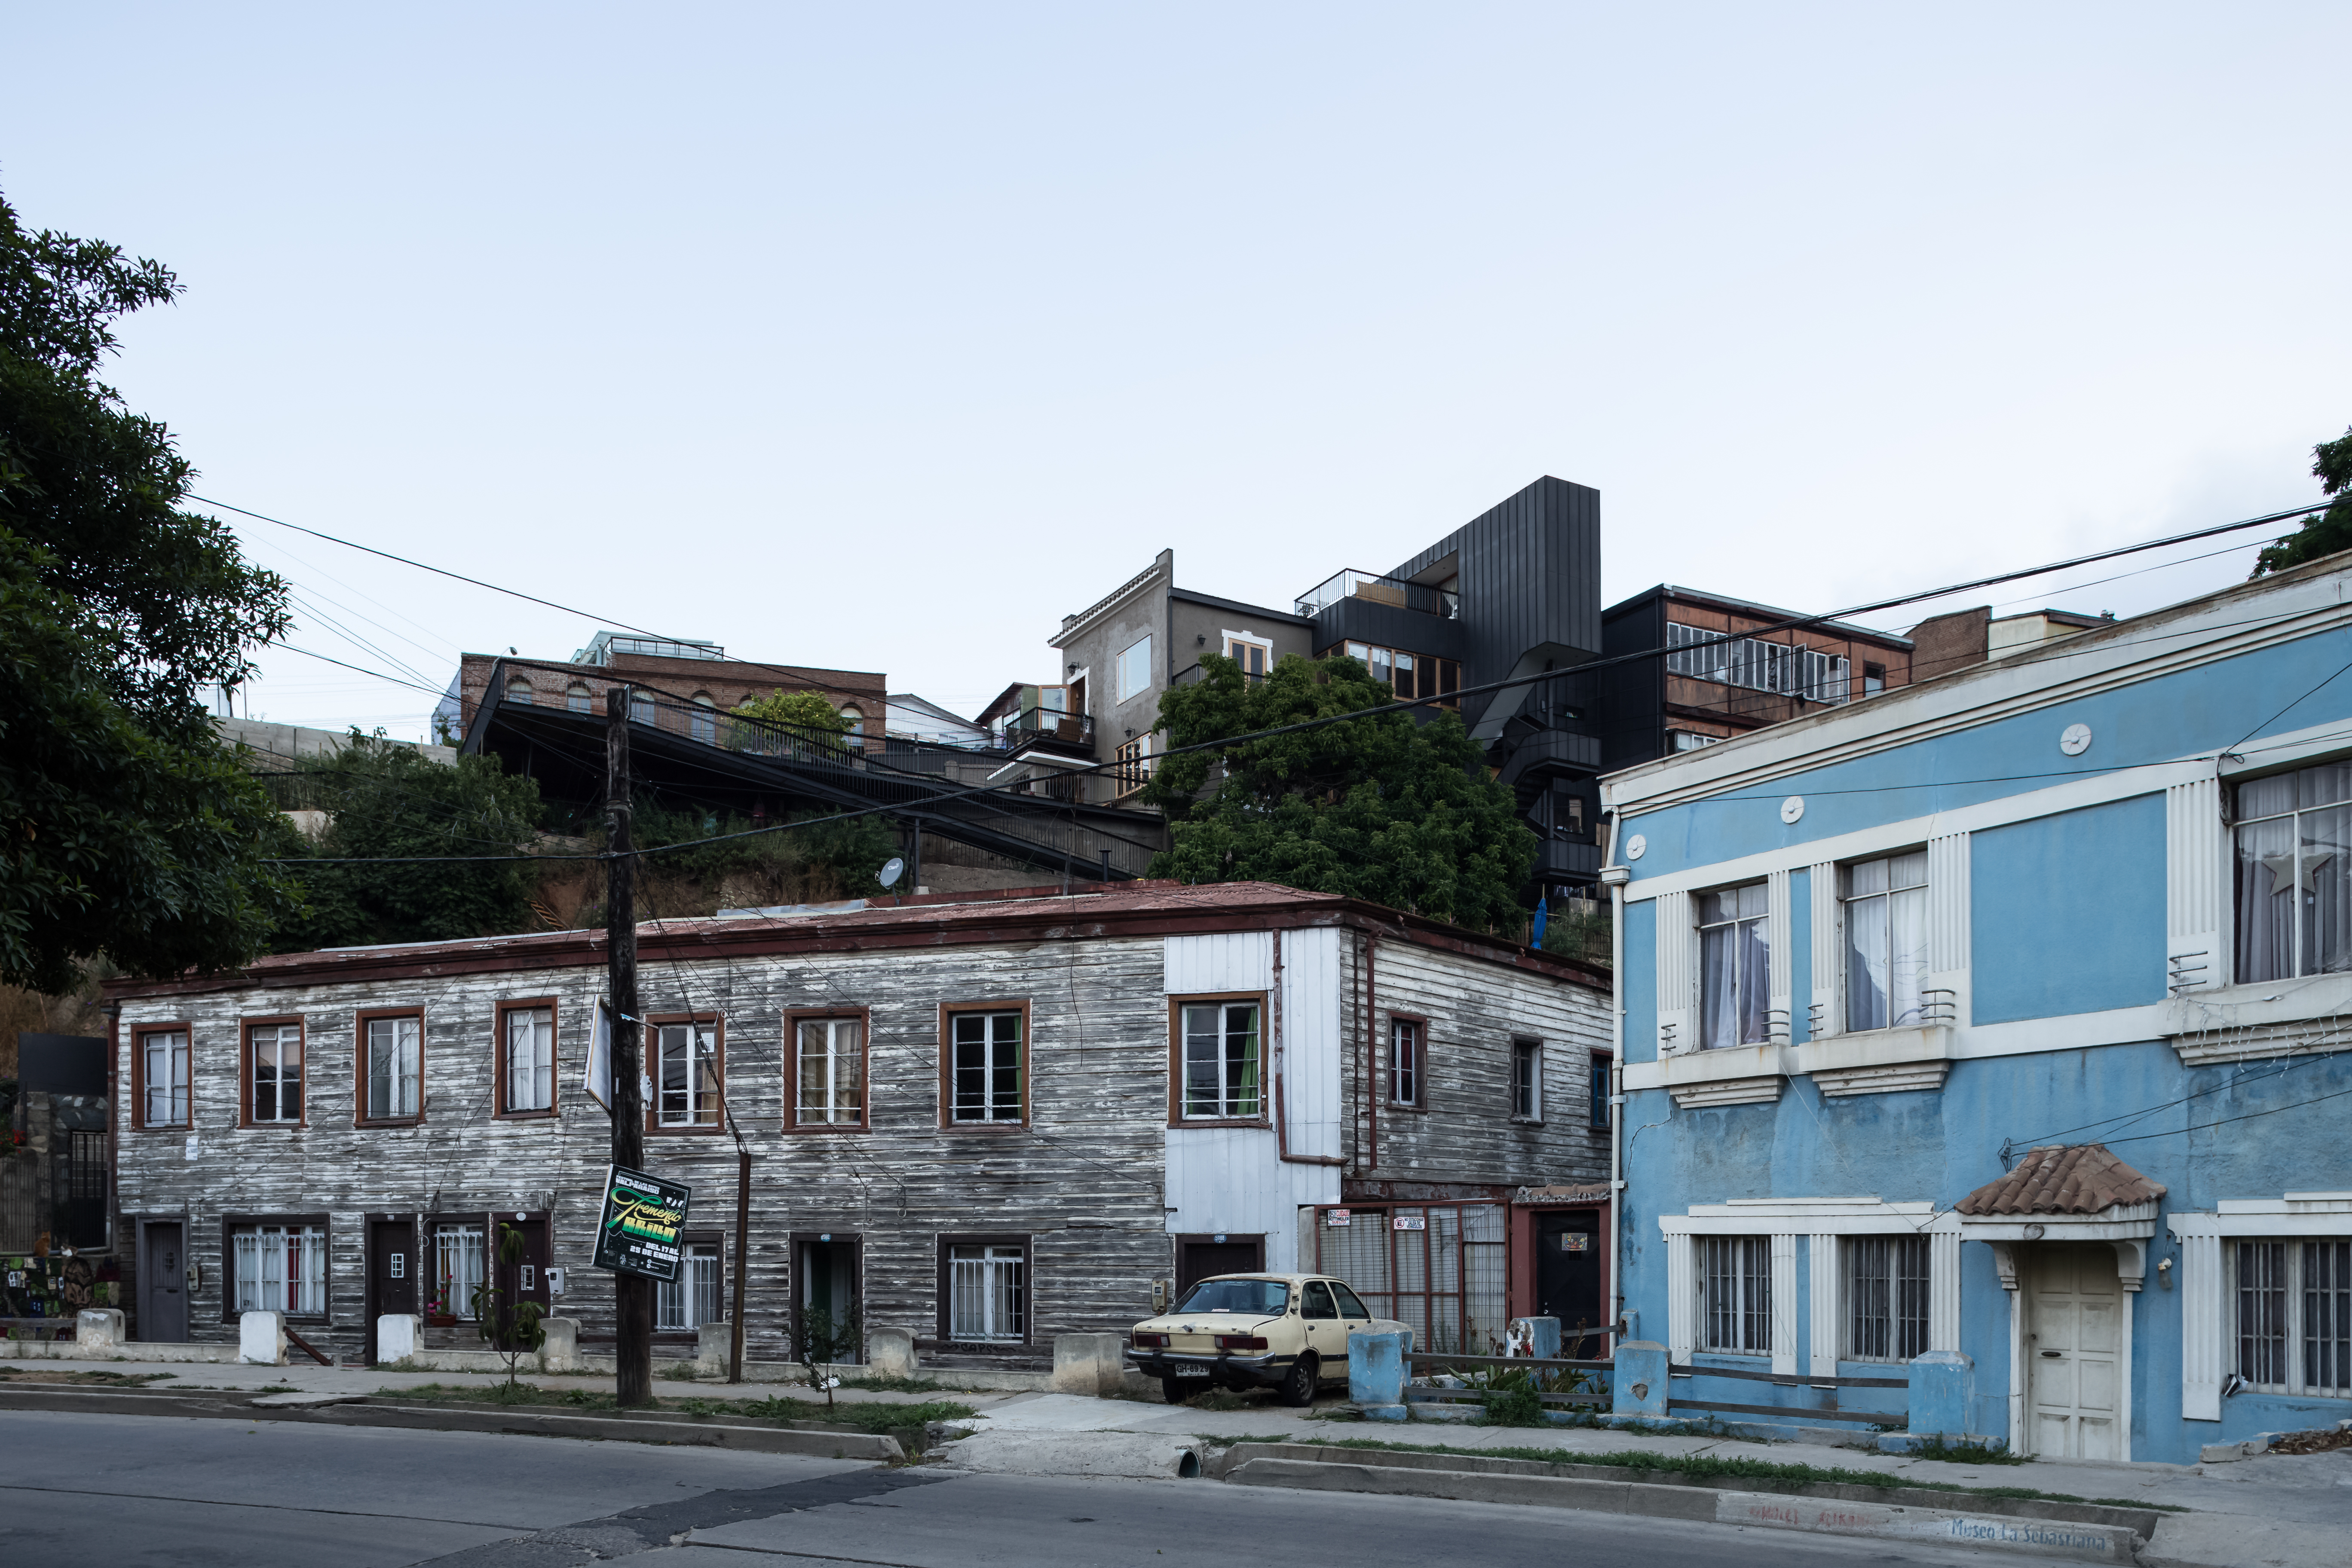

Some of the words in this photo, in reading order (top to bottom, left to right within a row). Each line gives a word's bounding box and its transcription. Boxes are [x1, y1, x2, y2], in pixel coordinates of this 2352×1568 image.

[606, 1187, 682, 1228] Tremendo
[630, 1245, 641, 1253] 25
[642, 1248, 652, 1256] DE
[653, 1251, 678, 1262] ENERO
[646, 1242, 661, 1251] DEL
[1952, 1518, 1995, 1539] Museo
[2000, 1523, 2018, 1542] La
[2023, 1524, 2106, 1550] Sebastiana
